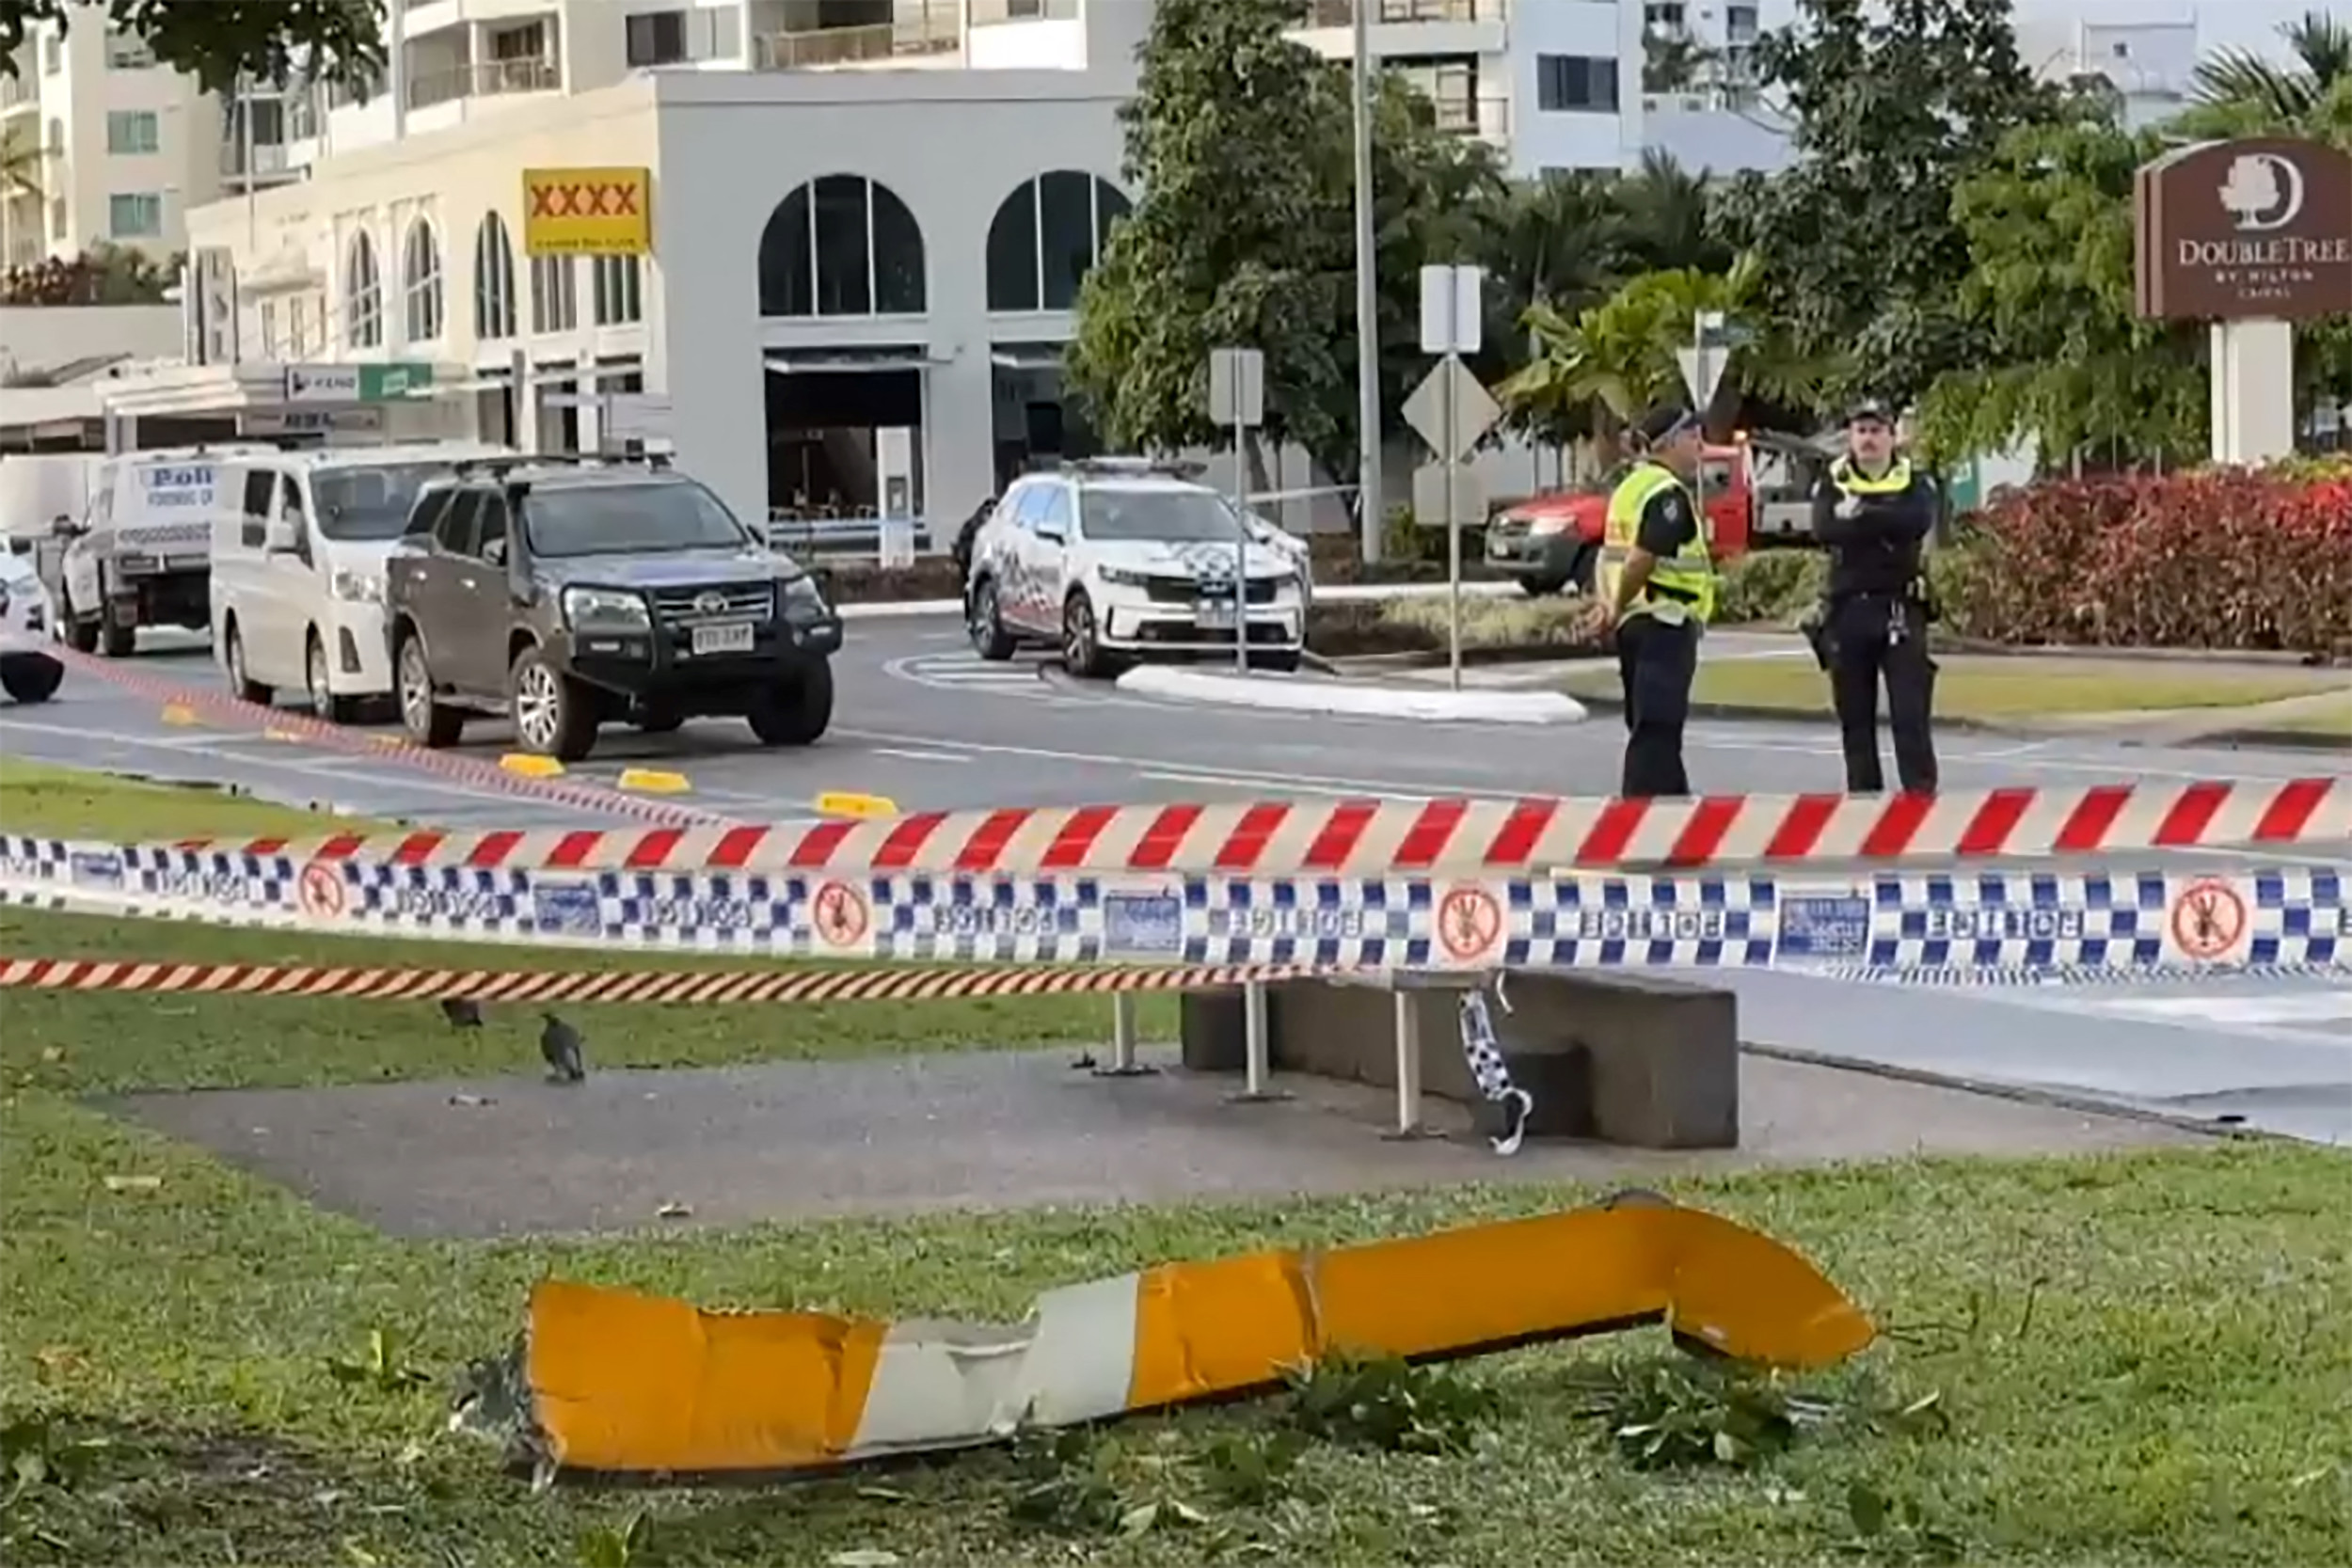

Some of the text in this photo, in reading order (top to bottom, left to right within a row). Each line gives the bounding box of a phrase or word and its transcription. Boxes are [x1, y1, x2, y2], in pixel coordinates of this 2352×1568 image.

[530, 183, 638, 216] XXXX
[2215, 267, 2313, 283] BY HILTON
[1580, 911, 1721, 939] POLICE
[1926, 910, 2083, 940] POLICE
